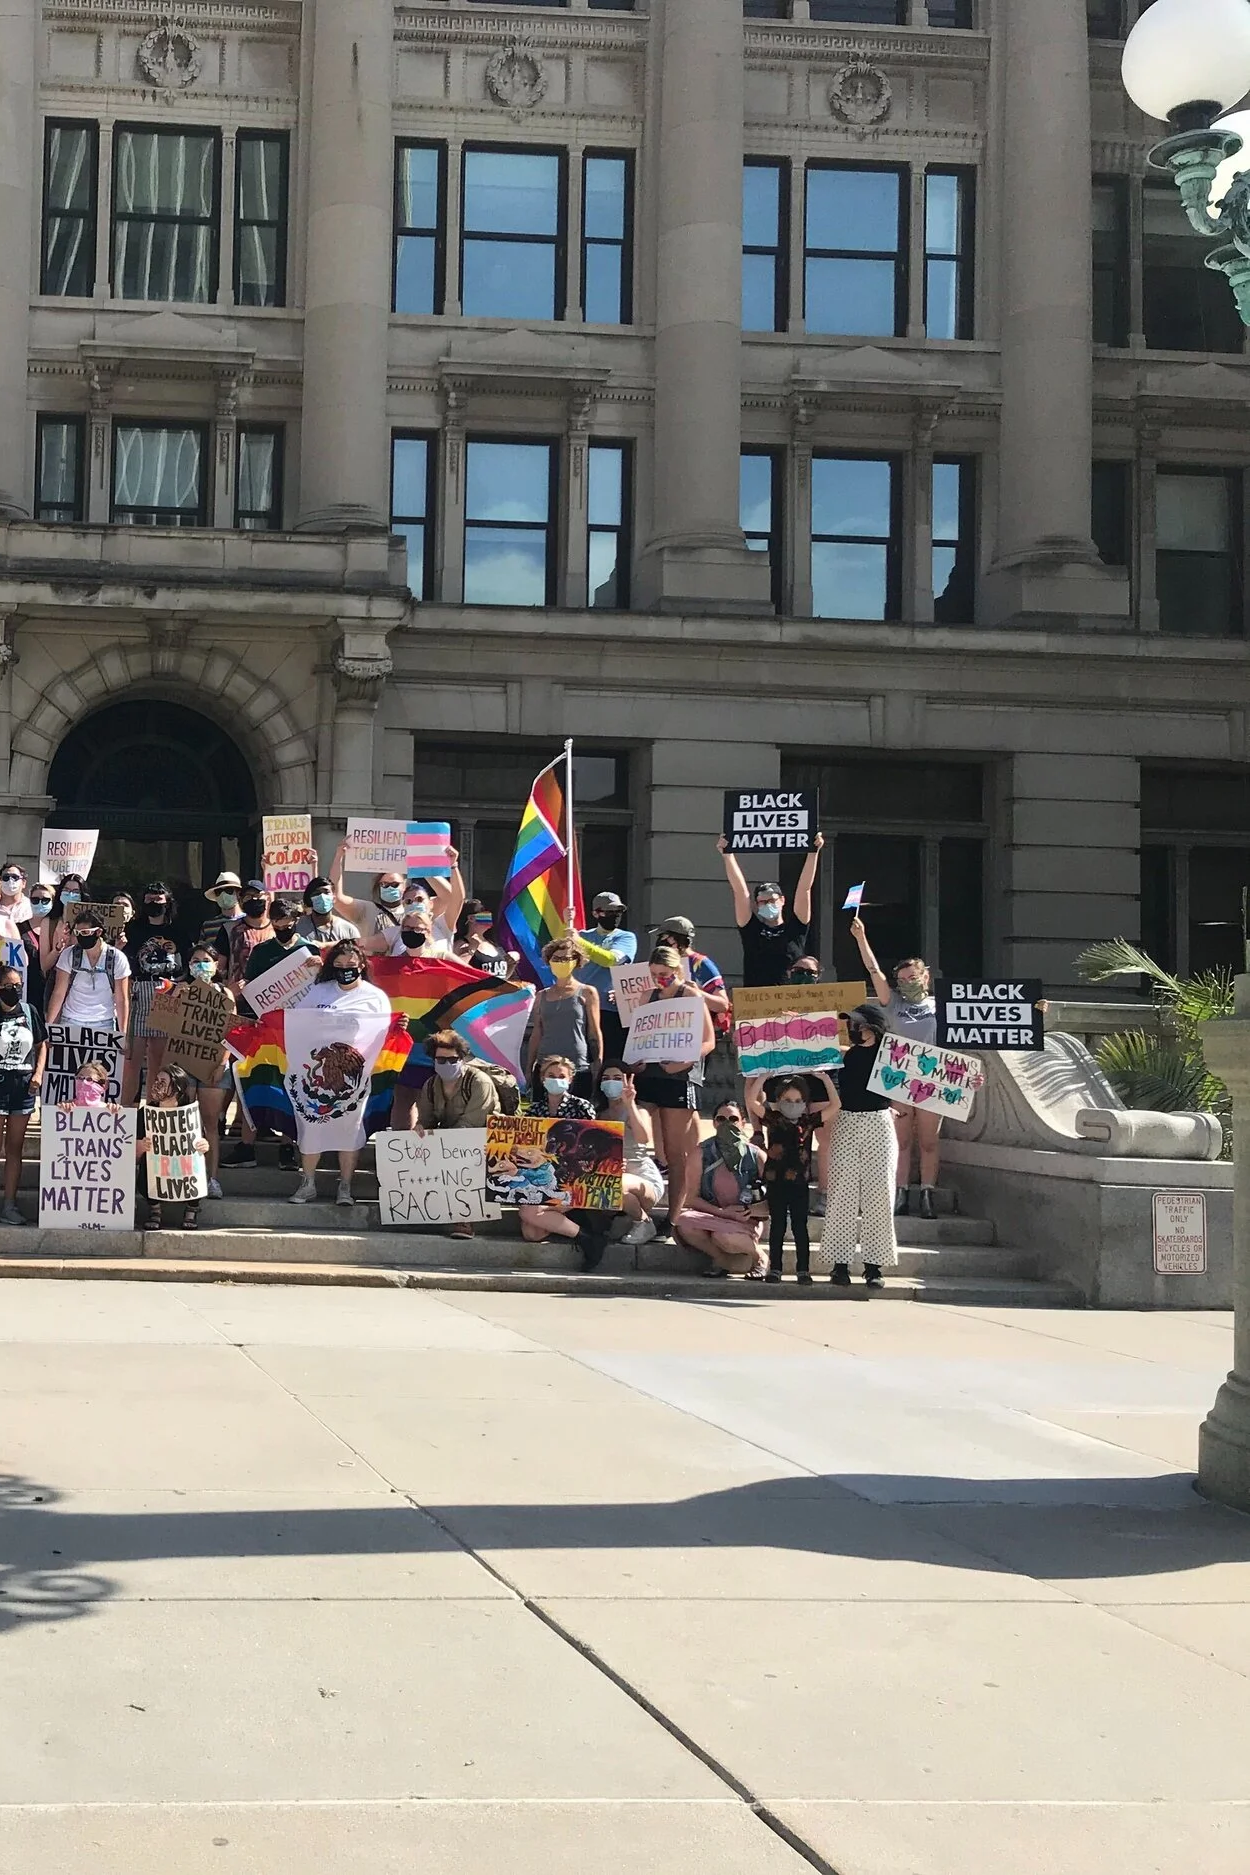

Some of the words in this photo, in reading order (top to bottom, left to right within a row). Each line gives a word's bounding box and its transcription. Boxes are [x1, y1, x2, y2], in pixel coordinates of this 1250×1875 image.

[739, 793, 803, 808] BLACK
[742, 813, 799, 828] LIVES
[265, 832, 309, 847] CHILDREN
[353, 829, 407, 846] RESILIENT
[732, 833, 809, 848] MATTER
[47, 841, 92, 857] RESILIENT
[266, 849, 311, 865] COLOR
[353, 847, 407, 862] TOGETHER
[47, 859, 89, 873] TOGETHER
[265, 872, 310, 892] LOVED
[255, 962, 312, 1010] RESILIENT
[951, 983, 1025, 1000] BLACK
[187, 985, 226, 1010] BLACK
[182, 1001, 227, 1027] TRANS
[634, 1012, 694, 1033] RESILIENT
[956, 1006, 1022, 1022] LIVES
[48, 1026, 124, 1050] BLACK
[181, 1021, 224, 1044] LIVES
[632, 1033, 693, 1051] TOGETHER
[946, 1027, 1034, 1045] MATTER
[168, 1038, 219, 1062] MATTER
[883, 1035, 933, 1060] BLACK
[939, 1051, 979, 1076] TRANS
[48, 1046, 116, 1077] LIVES
[879, 1051, 926, 1076] LIVES
[45, 1073, 121, 1105] MATR
[55, 1111, 127, 1135] BLACK
[146, 1107, 199, 1134] PROTECT
[60, 1137, 124, 1159] TRANS
[153, 1133, 196, 1156] BLACK
[440, 1137, 483, 1167] being
[51, 1158, 112, 1182] LIVES
[150, 1156, 199, 1177] TRANS
[156, 1176, 199, 1200] LIVES
[41, 1186, 125, 1215] MATTER
[1157, 1197, 1201, 1205] PEDESTRIAN
[1165, 1206, 1194, 1214] TRAFFIC
[1170, 1215, 1189, 1223] ONLY
[1175, 1226, 1185, 1234] NO
[1158, 1245, 1190, 1253] BICYCLES
[1161, 1254, 1200, 1262] MOTORIZED
